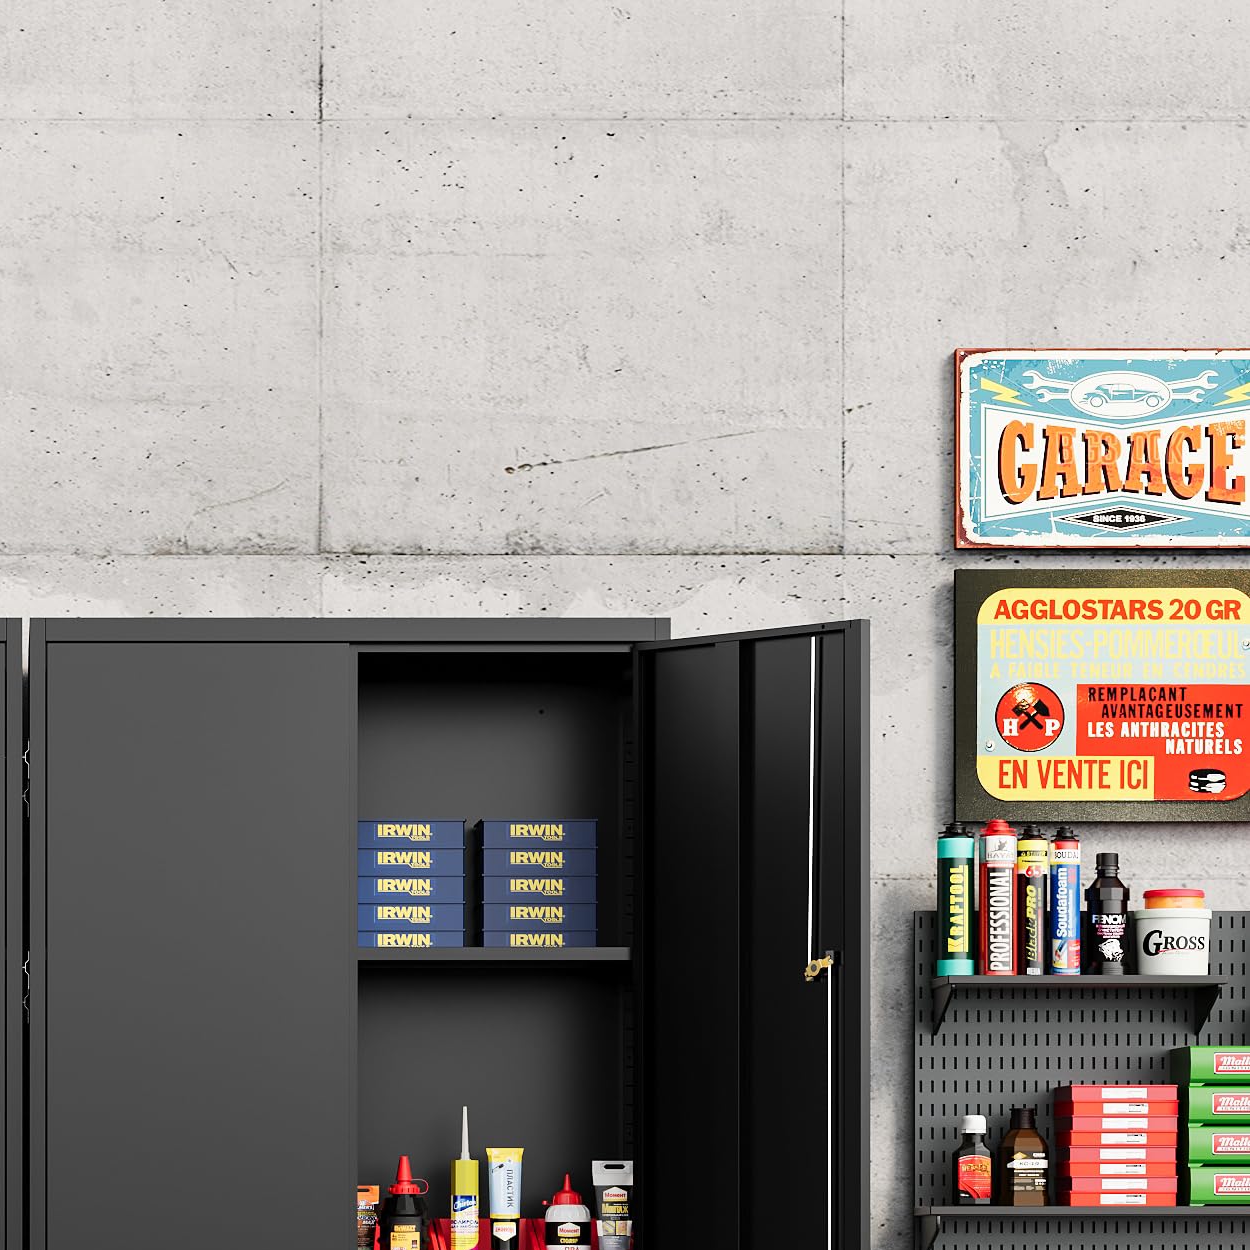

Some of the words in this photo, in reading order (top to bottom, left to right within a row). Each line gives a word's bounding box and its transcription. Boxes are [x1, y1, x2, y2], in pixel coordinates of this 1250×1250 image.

[998, 419, 1246, 505] GARAGE
[1092, 513, 1123, 523] SINCE
[993, 598, 1164, 620] AGGLOSTARS
[1169, 598, 1202, 620] 20
[1206, 598, 1242, 620] GR
[1008, 662, 1061, 679] FAIBLE
[1143, 662, 1163, 679] EN
[1172, 662, 1246, 679] CENDRES
[1088, 687, 1187, 702] REMPLACANT
[1101, 704, 1243, 719] AVANTAGEUSEMENT
[1002, 718, 1019, 736] H
[1044, 718, 1060, 736] P
[1087, 722, 1115, 738] LES
[1121, 722, 1225, 738] ANTHRACITES
[1165, 739, 1243, 755] NATURELS
[998, 760, 1028, 789] EN
[1037, 760, 1111, 789] VENTE
[1119, 760, 1148, 789] ICI
[377, 824, 431, 836] IRWIN
[510, 824, 563, 836] IRWIN
[377, 851, 431, 864] IRWIN
[510, 851, 563, 864] IRWIN
[377, 879, 431, 890] IRWIN
[510, 879, 563, 890] IRWIN
[947, 864, 965, 953] KRAFTOOL
[1056, 867, 1068, 938] Soudafoam
[377, 906, 431, 918] IRWIN
[510, 906, 563, 918] IRWIN
[990, 868, 1010, 971] PROFESSIONAL
[1091, 914, 1126, 924] FENOM
[377, 934, 431, 946] IRWIN
[510, 934, 563, 946] IRWIN
[506, 1169, 514, 1208] ПЛАСТИК
